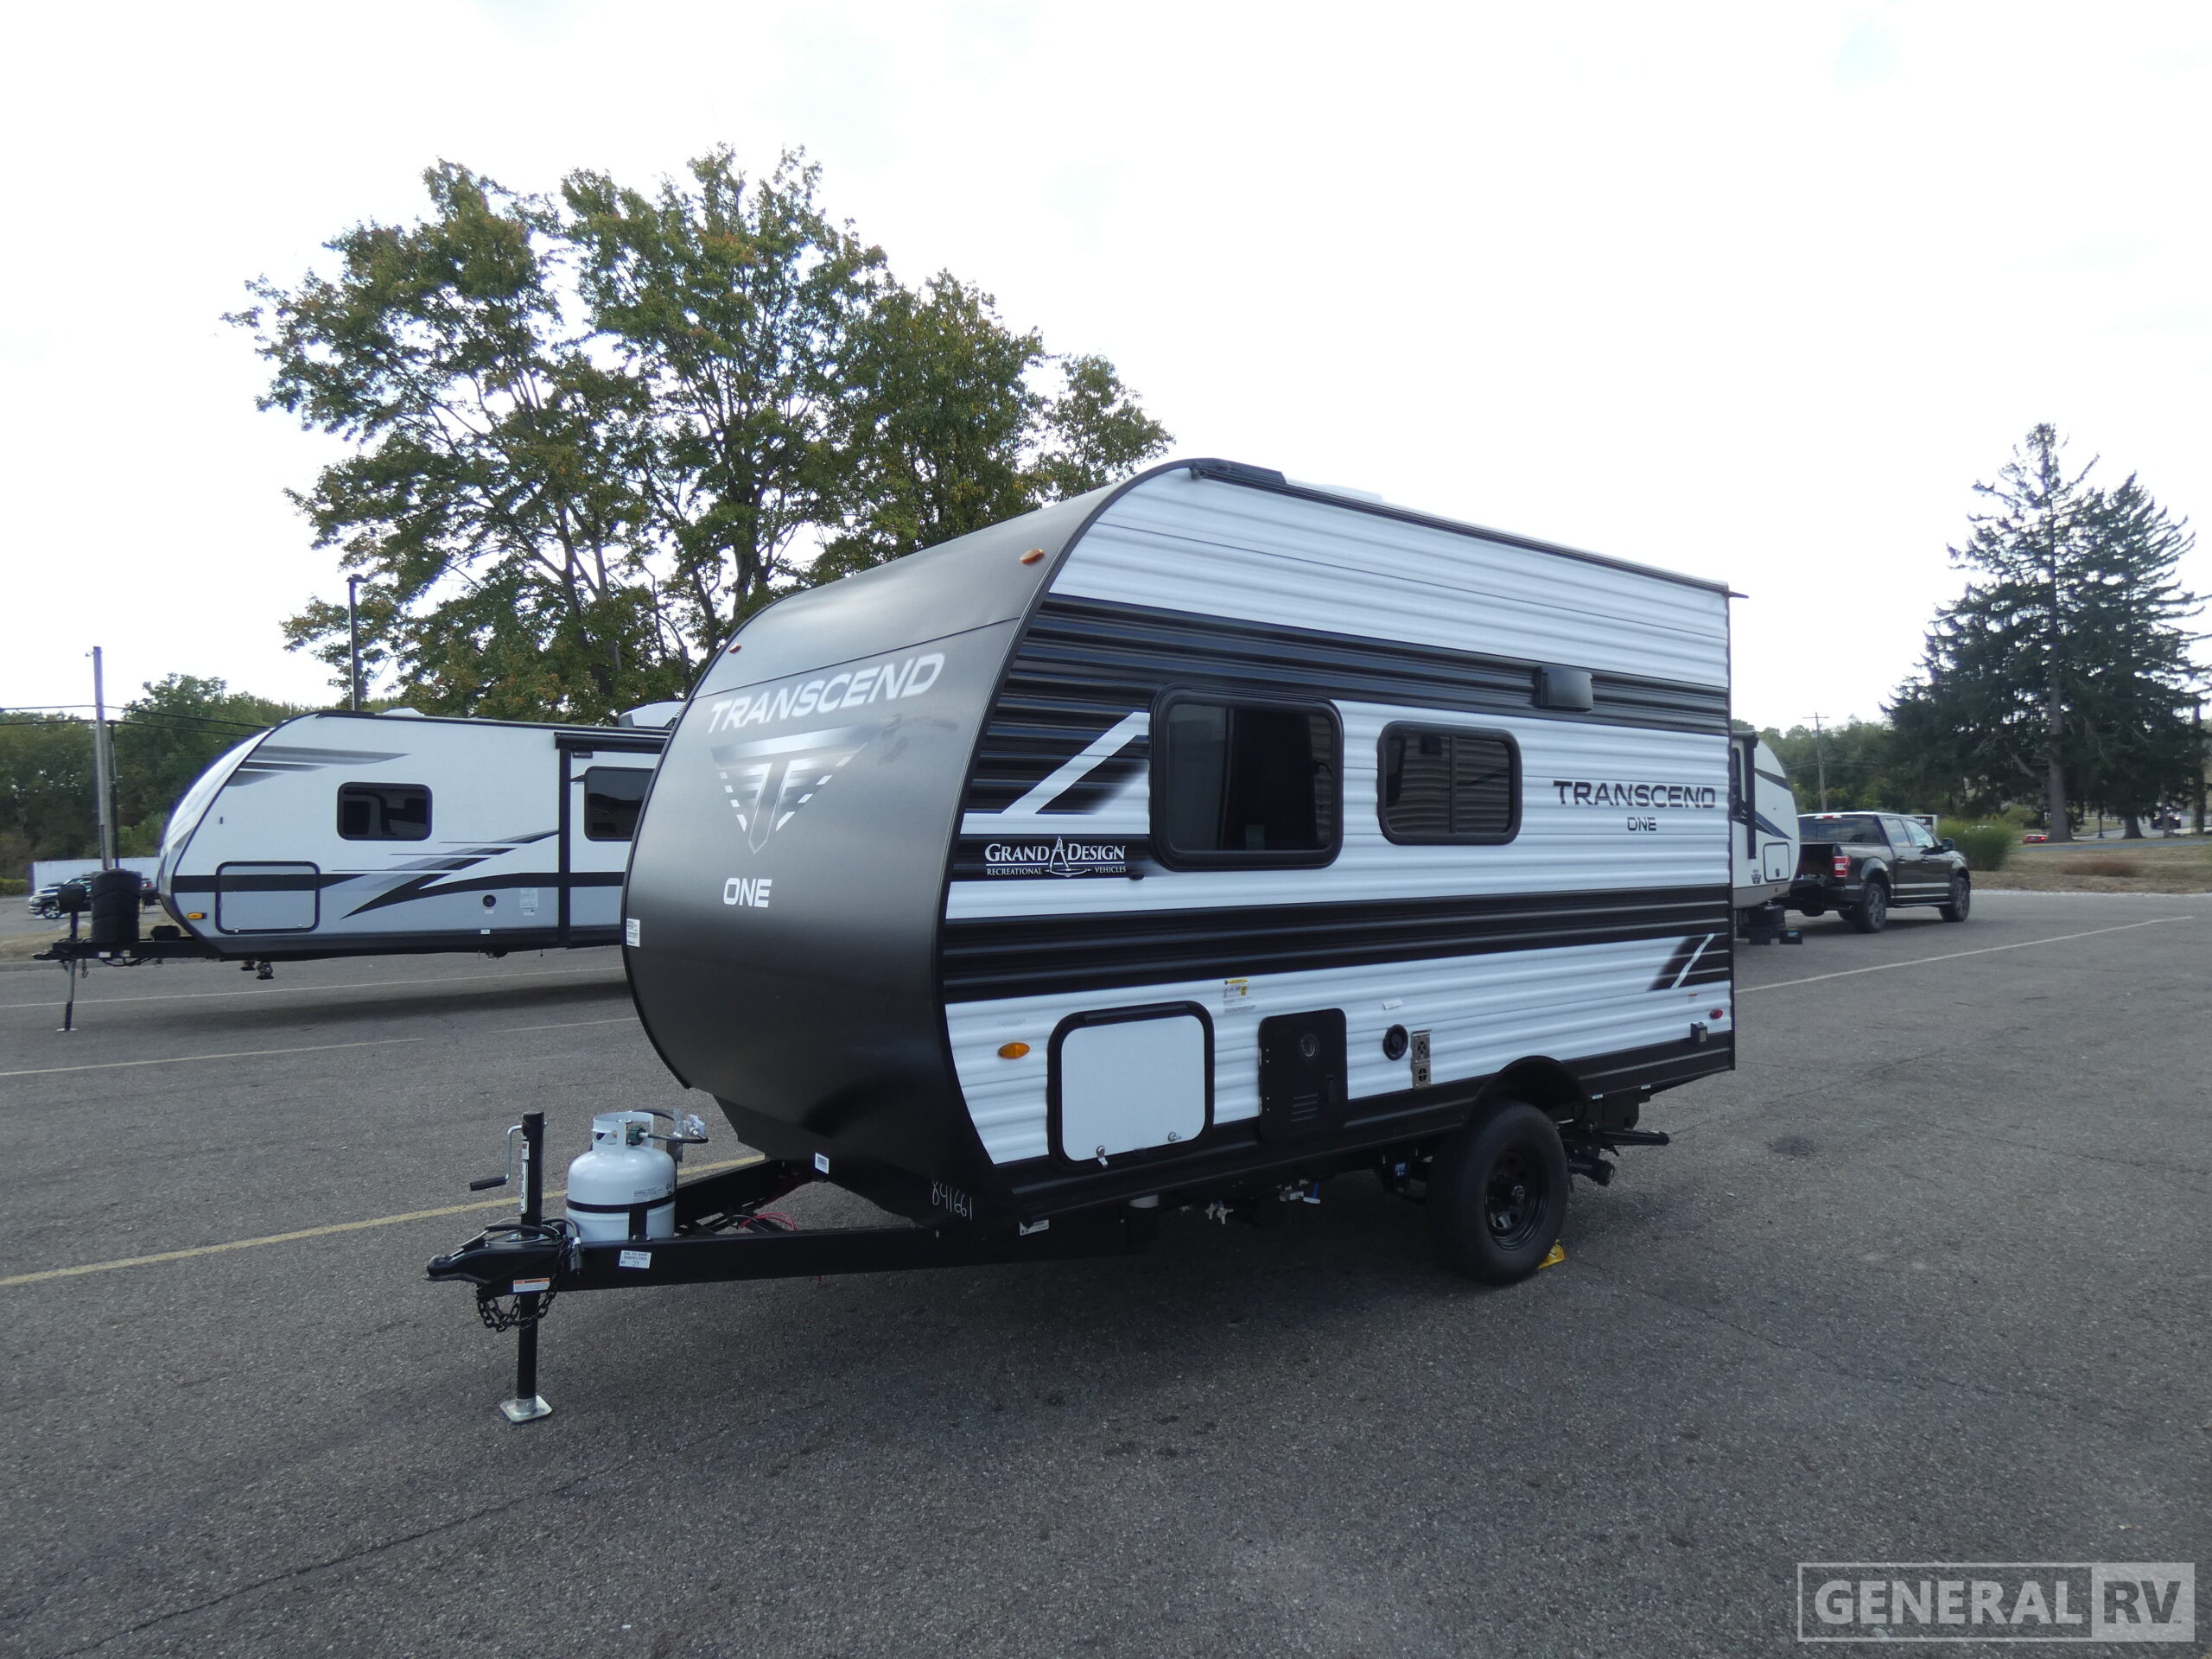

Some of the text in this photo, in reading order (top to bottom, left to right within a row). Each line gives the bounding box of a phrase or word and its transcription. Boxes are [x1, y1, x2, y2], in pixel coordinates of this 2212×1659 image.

[708, 652, 945, 733] TRANSCEND
[1553, 779, 1716, 809] TRANSCEND
[1626, 816, 1657, 831] ONE
[984, 842, 1126, 862] GRAND DESIGN
[986, 868, 1043, 876] RECREATIONAL
[723, 878, 772, 907] ONE
[931, 1179, 973, 1221] 841661
